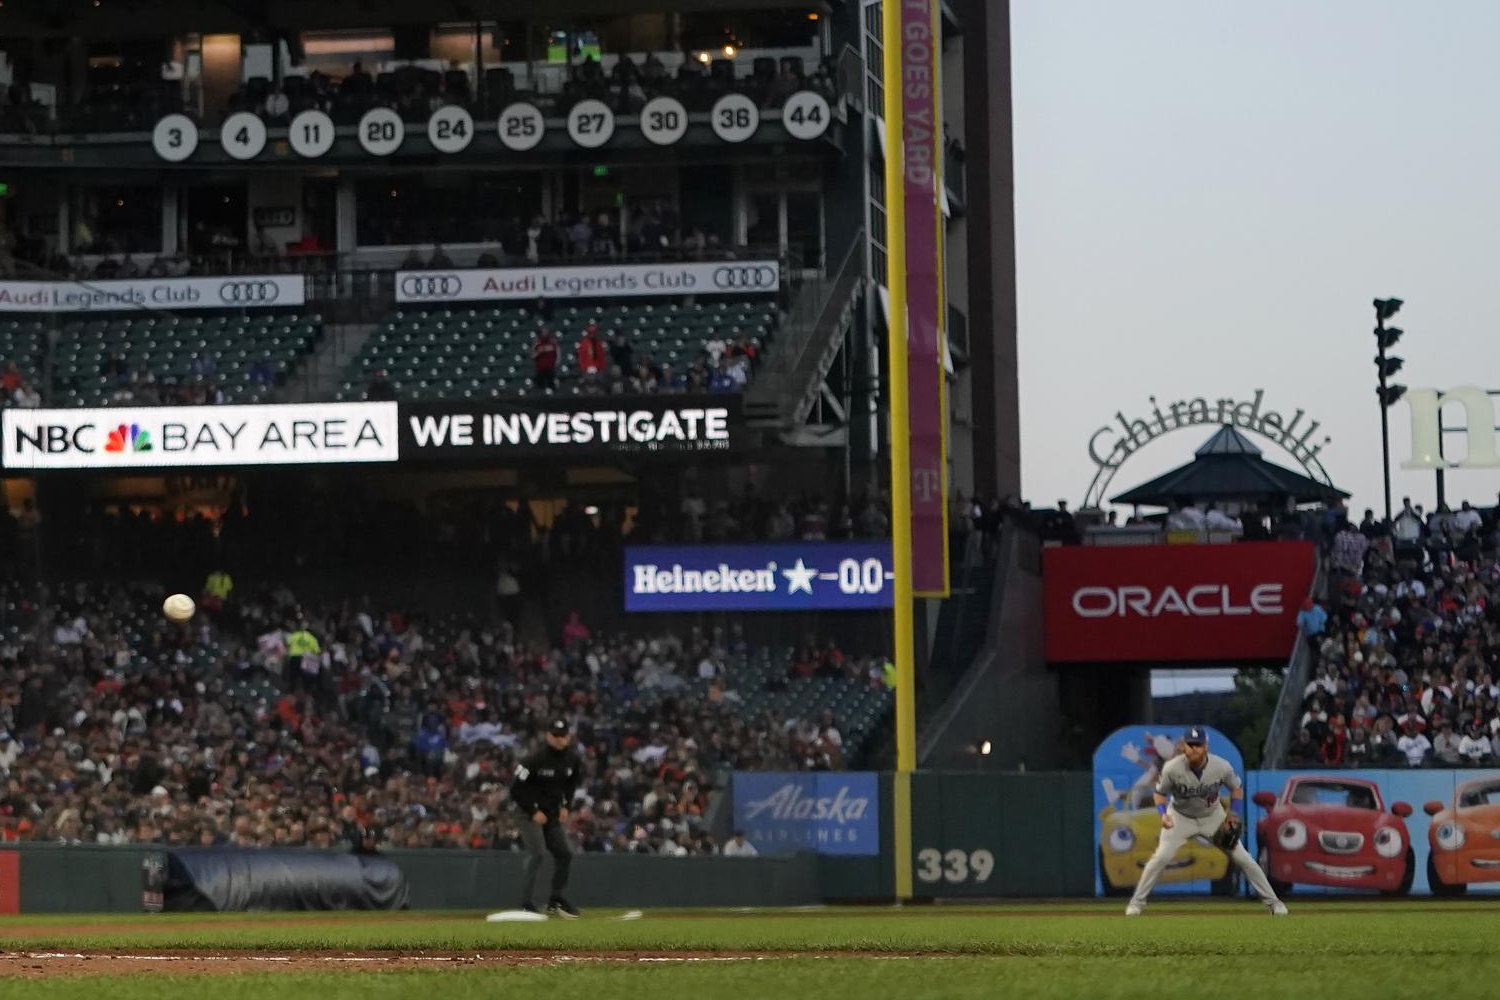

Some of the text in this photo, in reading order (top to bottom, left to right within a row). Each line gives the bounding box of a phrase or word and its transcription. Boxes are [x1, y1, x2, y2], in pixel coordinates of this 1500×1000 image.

[905, 24, 929, 101] GOES
[506, 116, 536, 137] 25
[576, 113, 605, 133] 27
[650, 110, 678, 131] 30
[721, 108, 749, 128] 36
[790, 105, 823, 125] 44
[168, 128, 182, 148] 3
[235, 126, 250, 146] 4
[303, 124, 320, 143] 11
[367, 121, 396, 141] 20
[437, 119, 467, 139] 24
[907, 107, 932, 186] YARD
[483, 269, 696, 297] Audi Legends Club
[53, 285, 146, 309] Legends
[151, 284, 201, 303] Club
[15, 419, 383, 453] NBC BAY AREA
[410, 408, 729, 447] WE INVESTIGATE
[1088, 389, 1332, 468] Ghirardelli
[633, 562, 777, 594] Heineken
[1072, 584, 1284, 618] ORACLE
[747, 783, 869, 825] Alaska
[916, 847, 996, 883] 339
